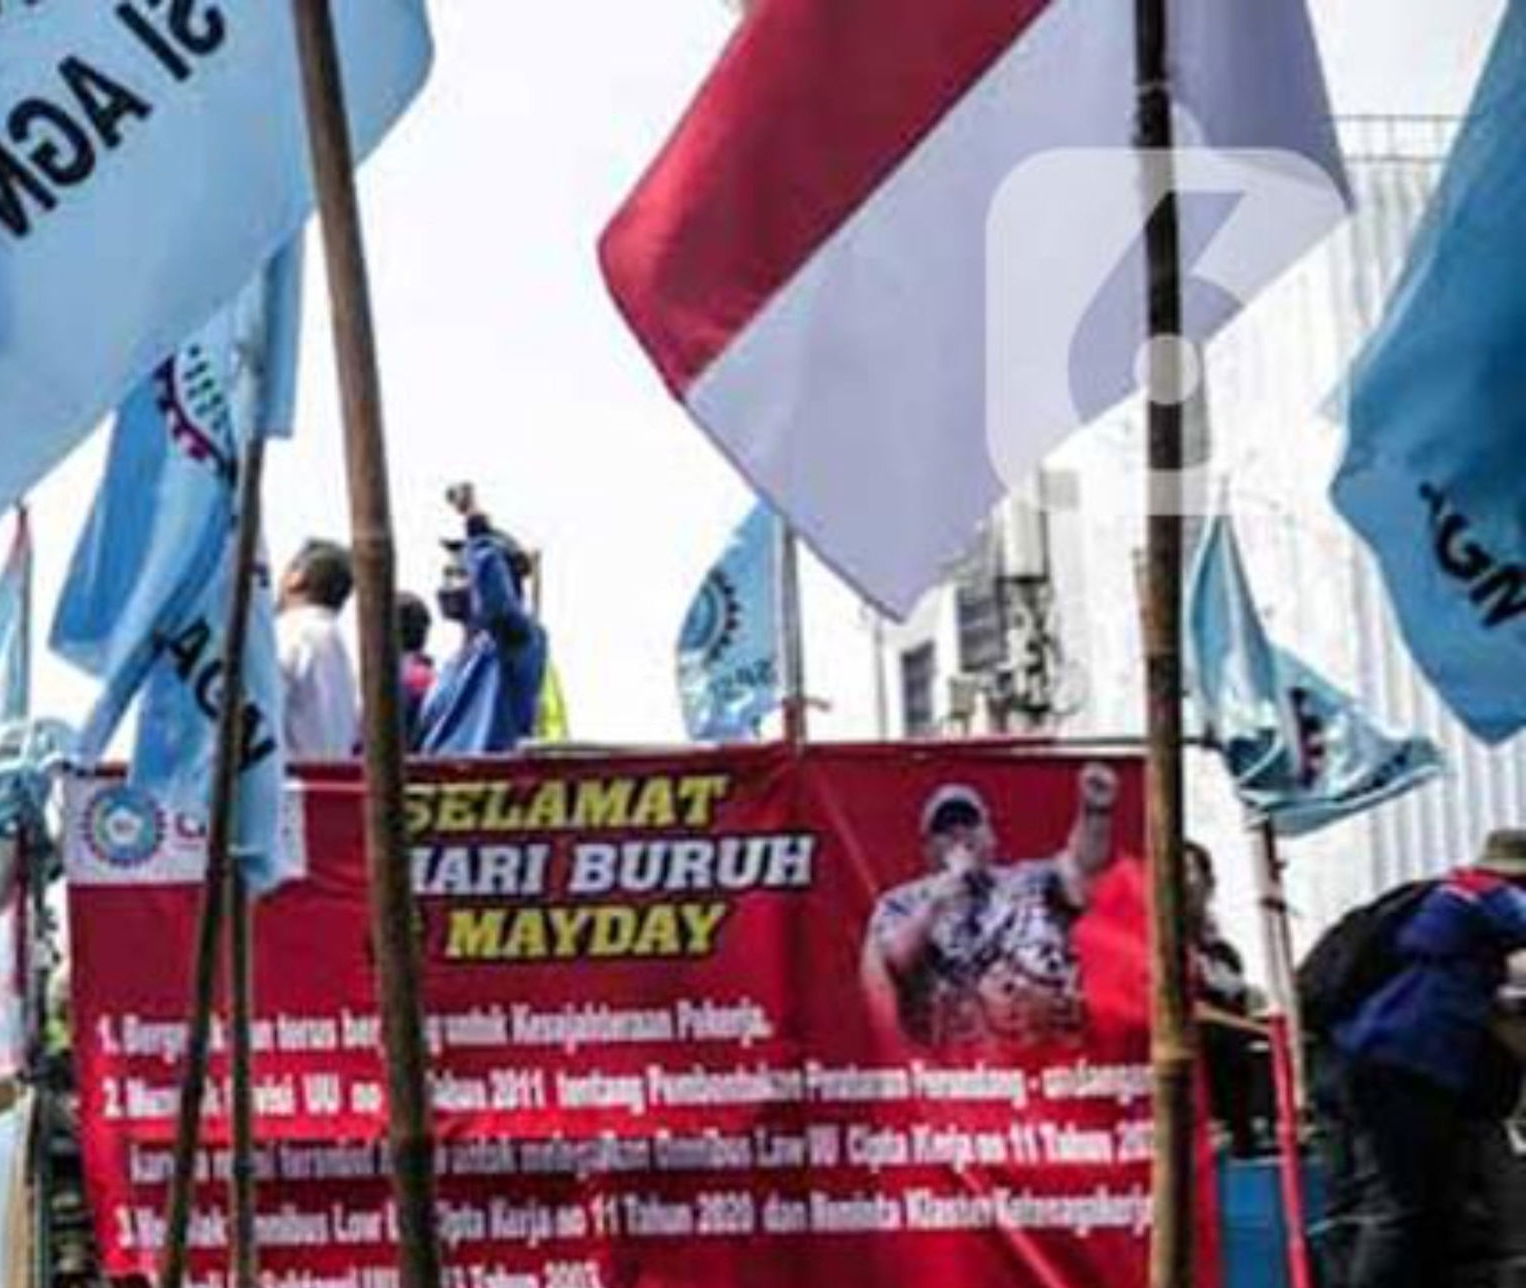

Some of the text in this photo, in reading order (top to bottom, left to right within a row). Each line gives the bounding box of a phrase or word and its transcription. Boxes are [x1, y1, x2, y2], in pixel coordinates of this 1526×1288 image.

[403, 774, 730, 834] SELAMAT
[569, 834, 816, 894] BURUH
[445, 902, 727, 960] MAYDAY
